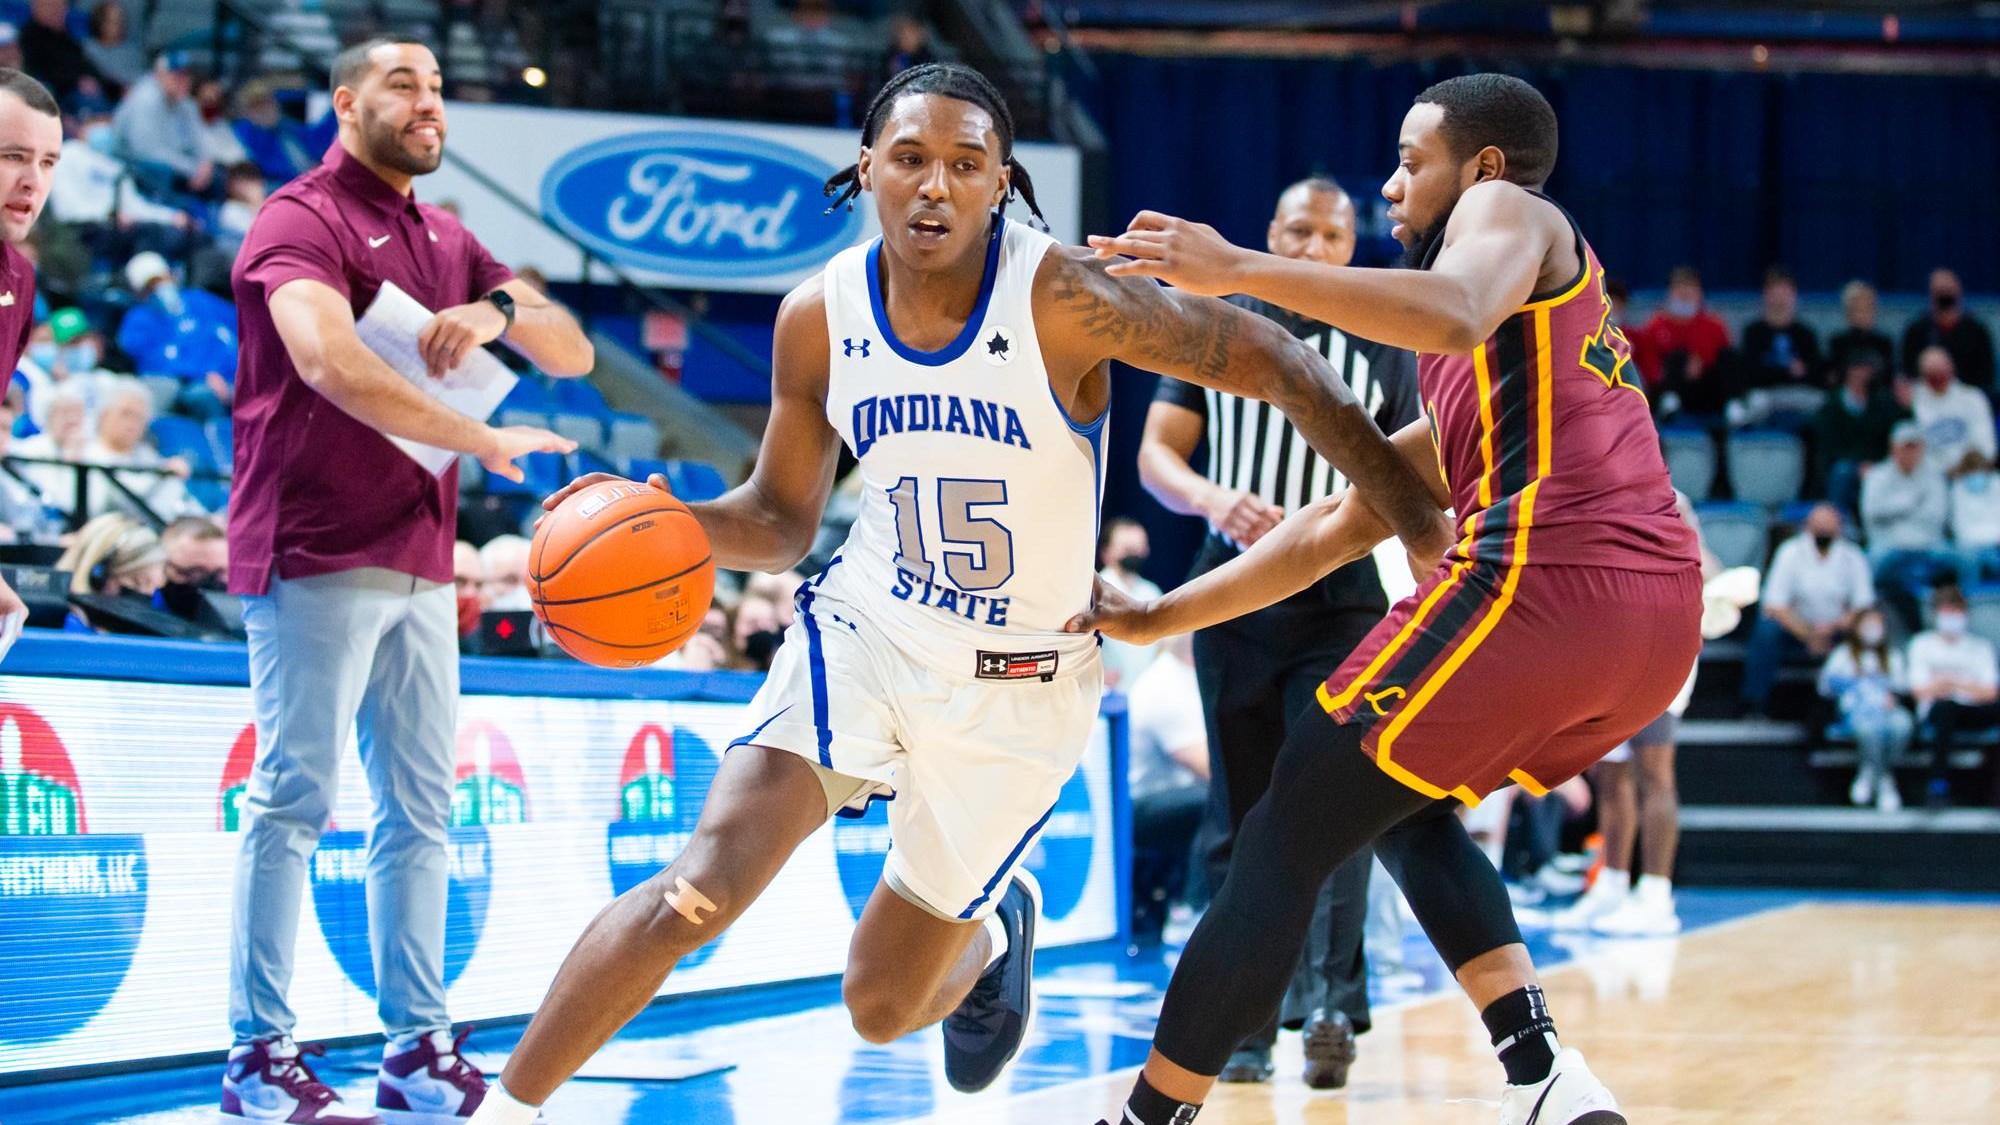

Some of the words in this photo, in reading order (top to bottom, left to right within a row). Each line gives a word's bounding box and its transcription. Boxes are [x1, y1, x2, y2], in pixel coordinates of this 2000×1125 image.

[608, 154, 798, 250] Ford
[852, 393, 1033, 460] INDIANA
[886, 476, 1015, 591] 15
[890, 567, 1010, 627] STATE
